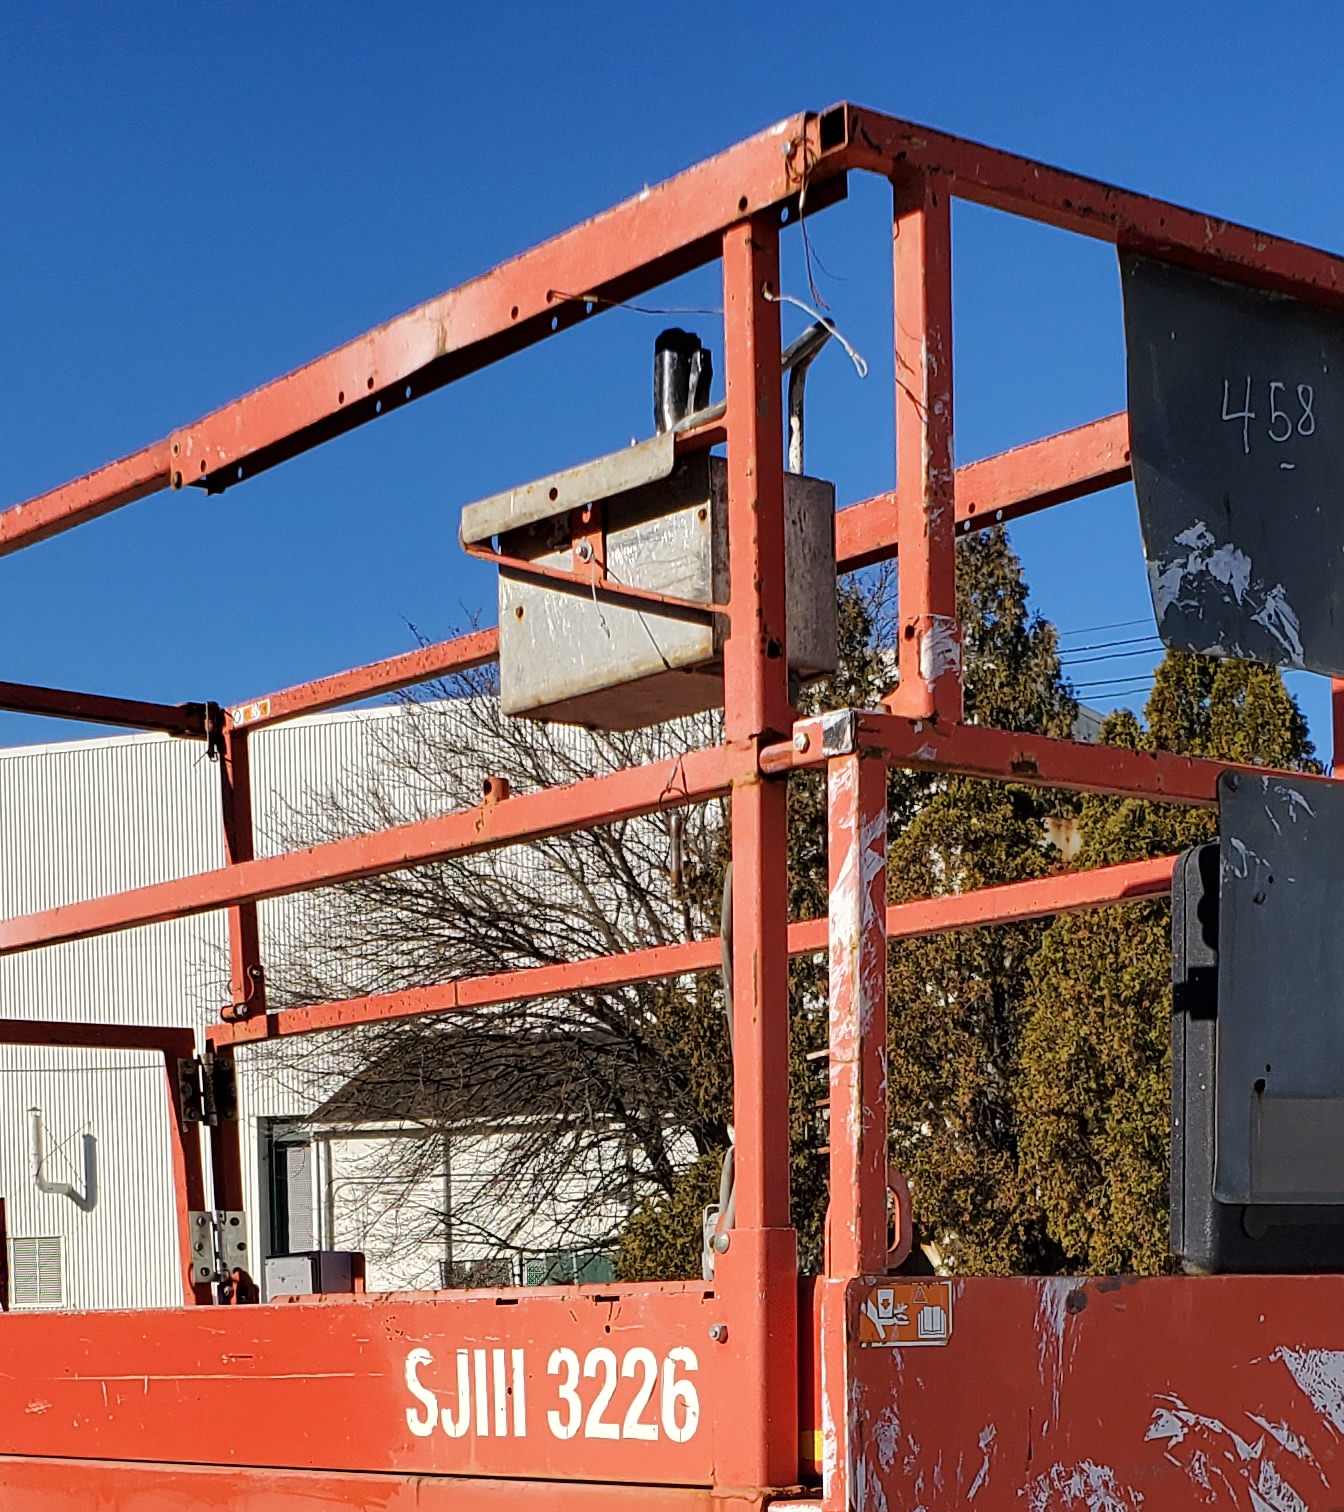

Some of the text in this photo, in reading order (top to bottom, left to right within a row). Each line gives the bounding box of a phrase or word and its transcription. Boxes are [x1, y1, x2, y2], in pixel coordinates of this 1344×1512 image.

[1222, 376, 1316, 453] 458
[406, 1347, 700, 1443] SJIII 3226
